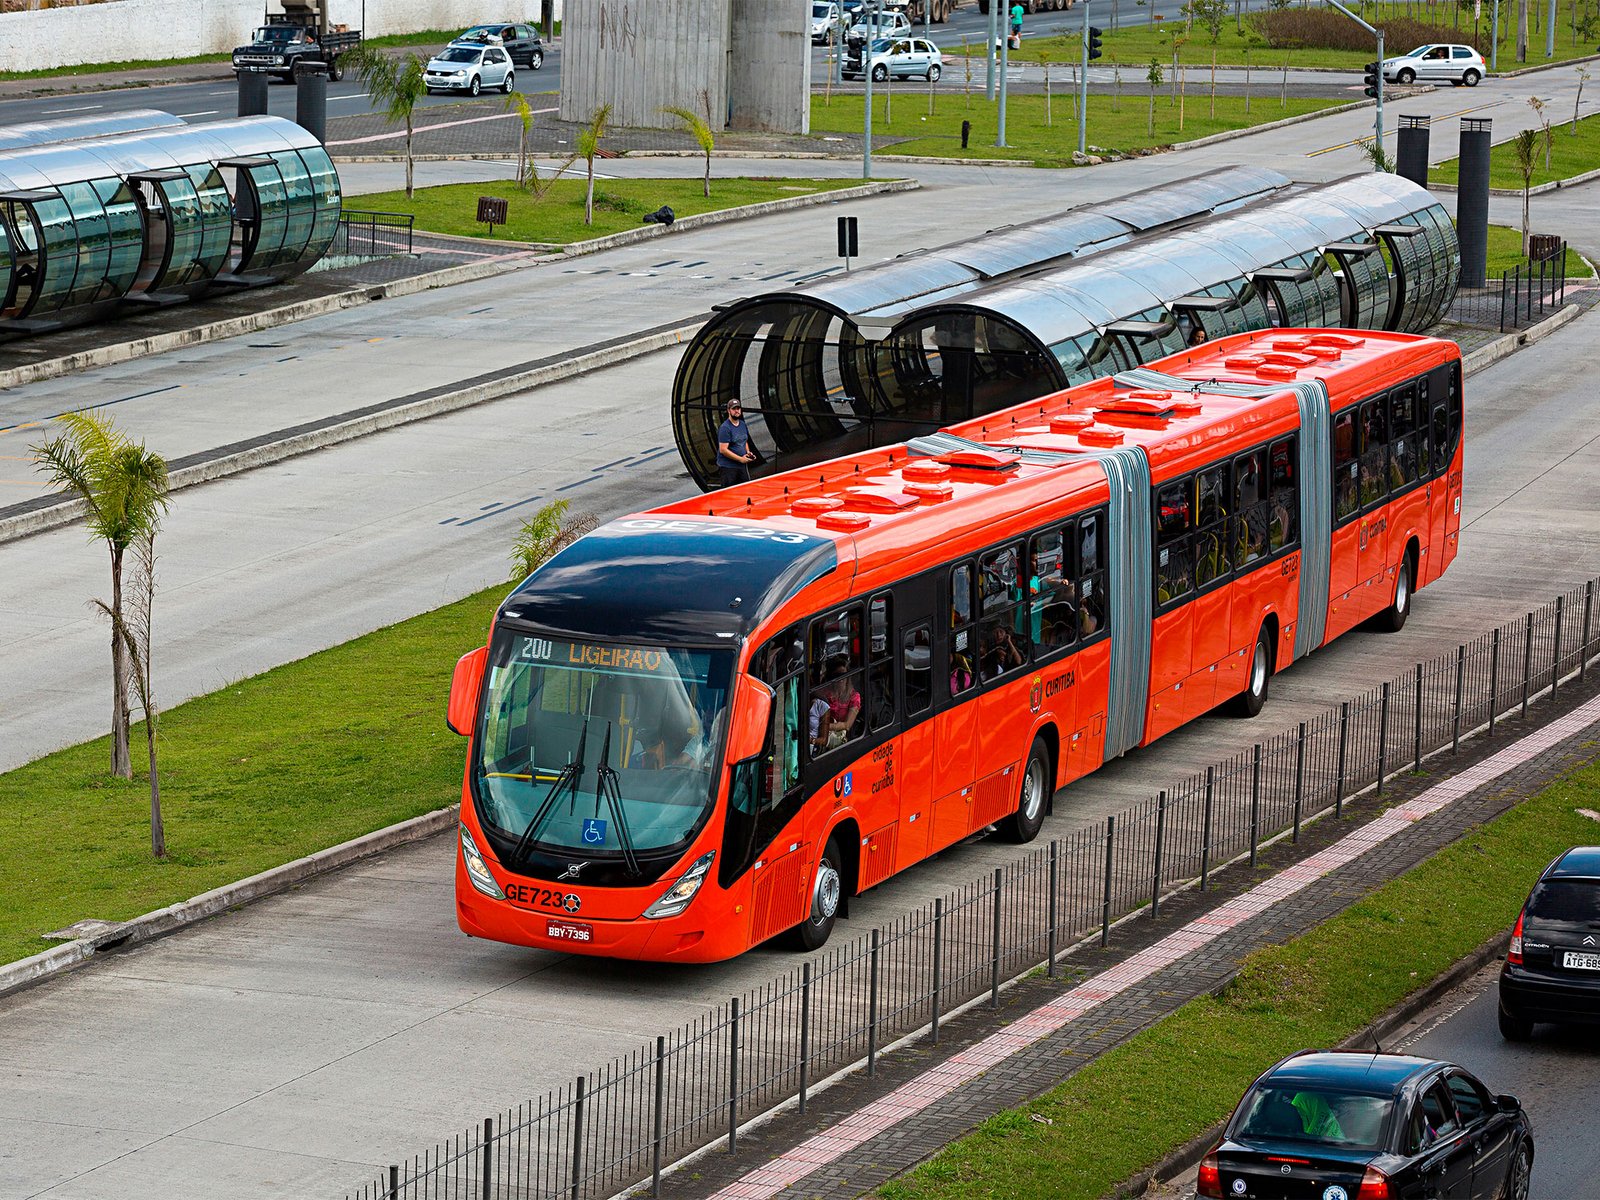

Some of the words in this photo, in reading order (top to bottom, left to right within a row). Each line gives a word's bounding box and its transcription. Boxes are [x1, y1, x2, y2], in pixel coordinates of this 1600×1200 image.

[621, 519, 809, 543] GE723
[521, 636, 552, 660] 200
[1045, 670, 1075, 698] CURITIBA
[873, 742, 893, 762] cidade
[885, 758, 892, 772] de
[872, 773, 894, 794] curitiba
[505, 883, 563, 908] GE723
